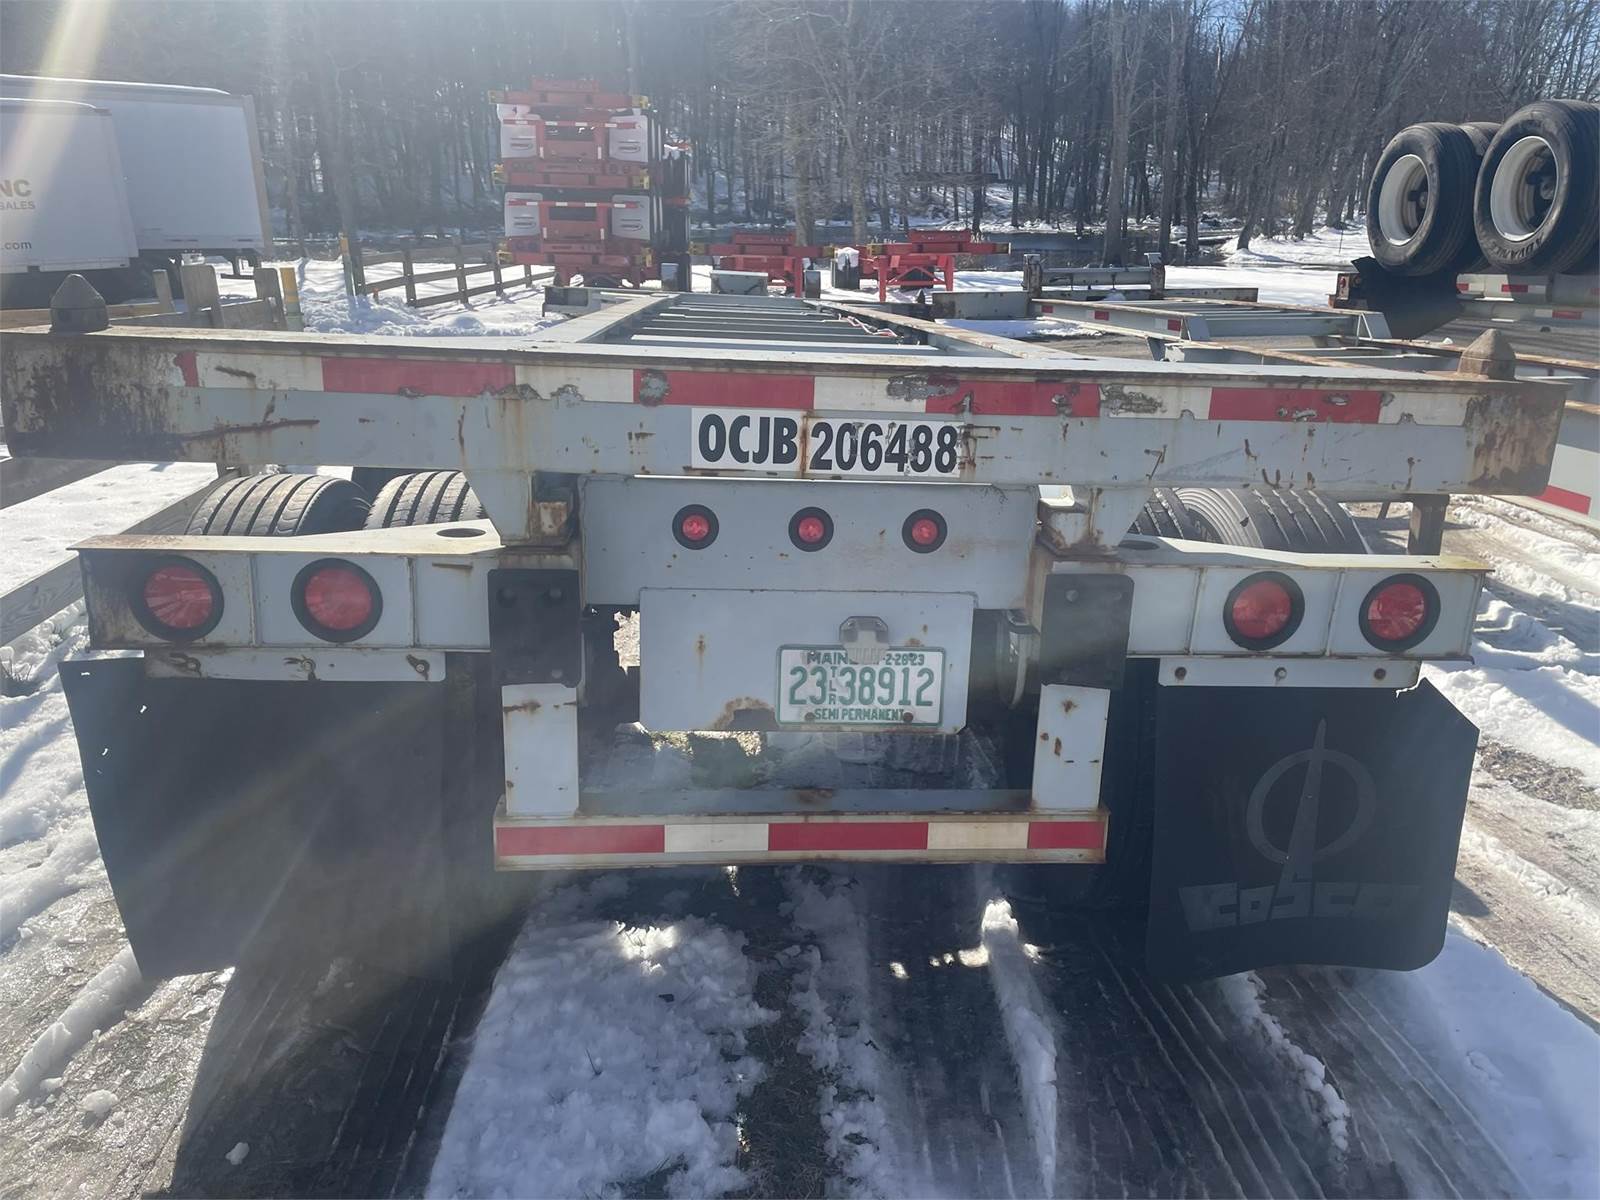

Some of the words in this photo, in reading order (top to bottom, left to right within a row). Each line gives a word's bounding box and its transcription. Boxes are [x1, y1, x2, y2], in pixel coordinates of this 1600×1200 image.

[698, 413, 798, 465] OCJB
[809, 421, 958, 474] 206488
[807, 652, 858, 665] MAIN
[789, 666, 828, 706] 23
[838, 666, 935, 707] 38912
[814, 708, 839, 721] SEMI
[841, 708, 904, 721] PERMANENT
